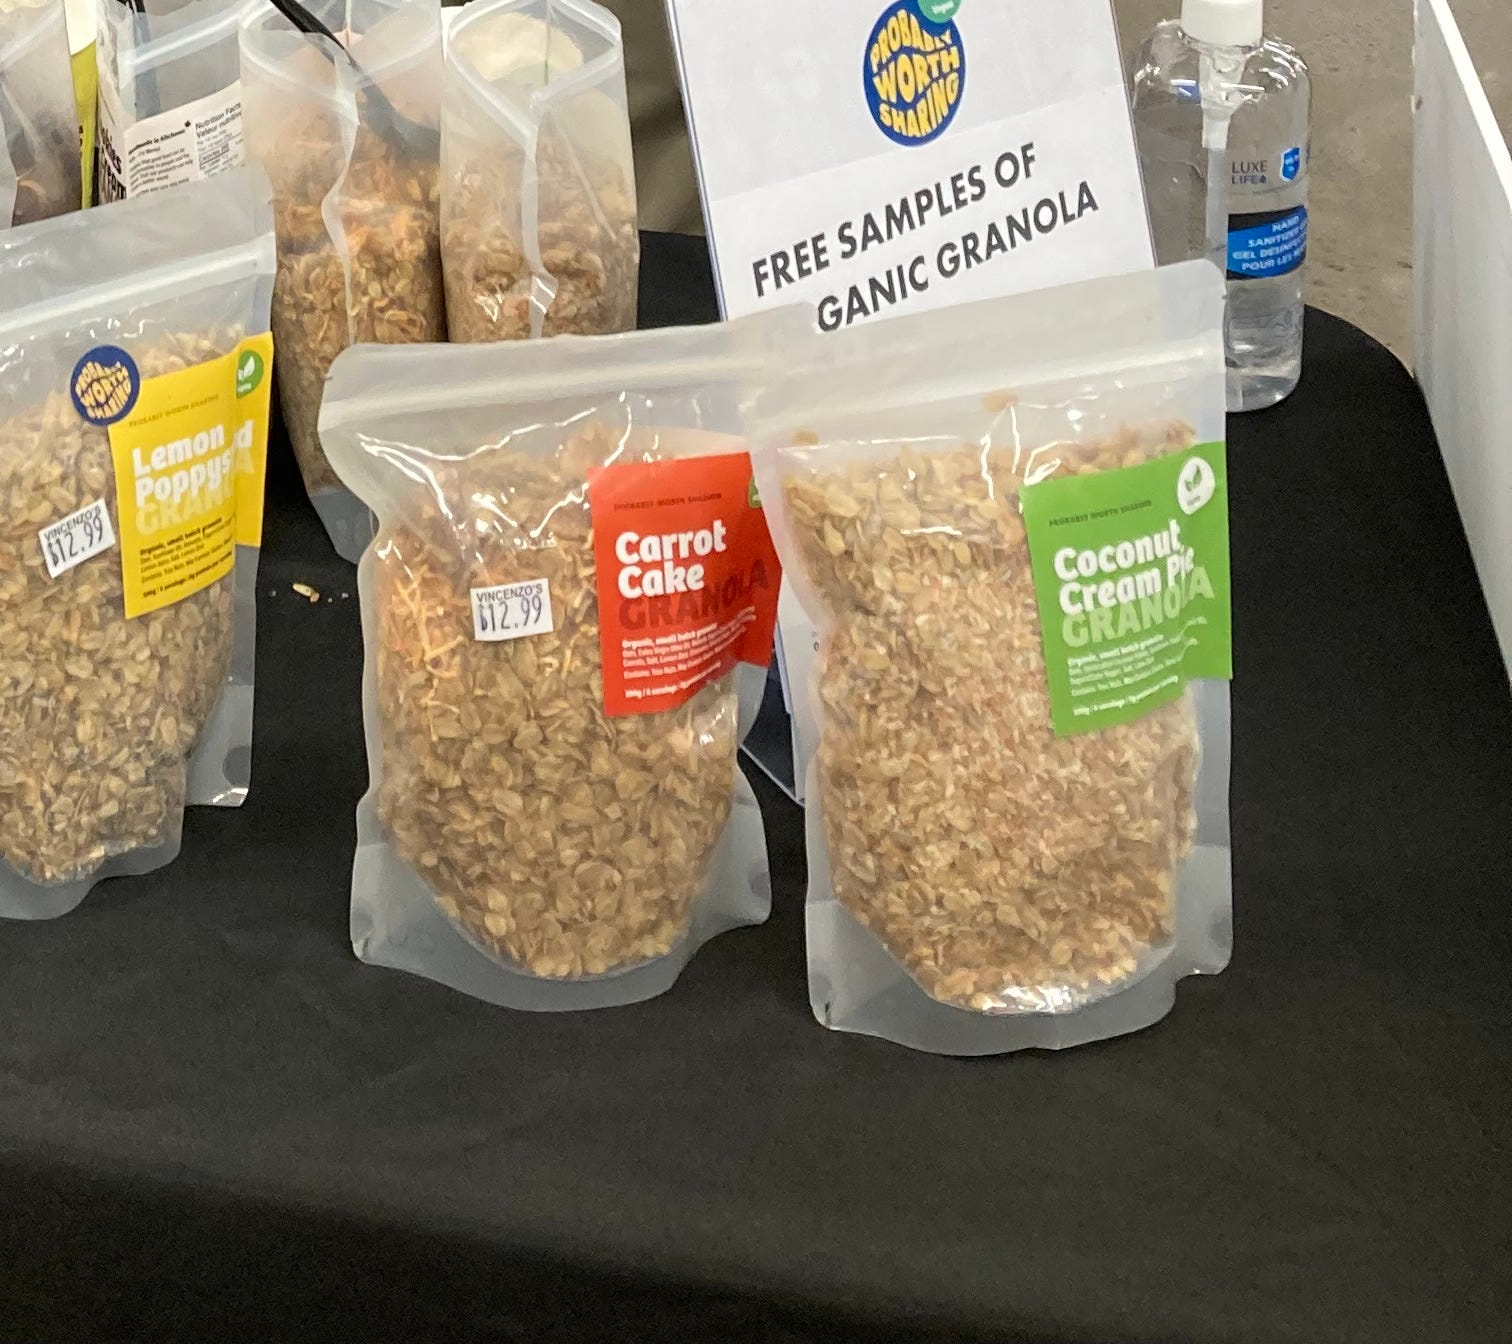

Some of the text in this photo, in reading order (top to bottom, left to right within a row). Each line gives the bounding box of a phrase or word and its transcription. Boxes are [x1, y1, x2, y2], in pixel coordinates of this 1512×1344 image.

[871, 10, 953, 70] PROBABLY
[873, 46, 959, 100] WORTH
[880, 78, 959, 139] SHARING
[1232, 160, 1267, 173] LUXE
[1232, 175, 1259, 184] LIFE
[752, 142, 1038, 298] FREE SAMPLES OF
[936, 181, 1100, 279] GRANOLA
[132, 424, 225, 477] Lemon
[44, 505, 101, 541] VINCENZO'S
[47, 519, 104, 569] $12.99
[616, 519, 727, 564] Carrot
[1054, 519, 1182, 581] Coconut
[476, 583, 543, 603] VINCENZO'S
[618, 561, 705, 599] Cake
[619, 559, 769, 631] GRANOLA
[1059, 546, 1195, 616] Cream Pie
[479, 595, 542, 632] $12.99
[1062, 567, 1216, 647] GRANOLA
